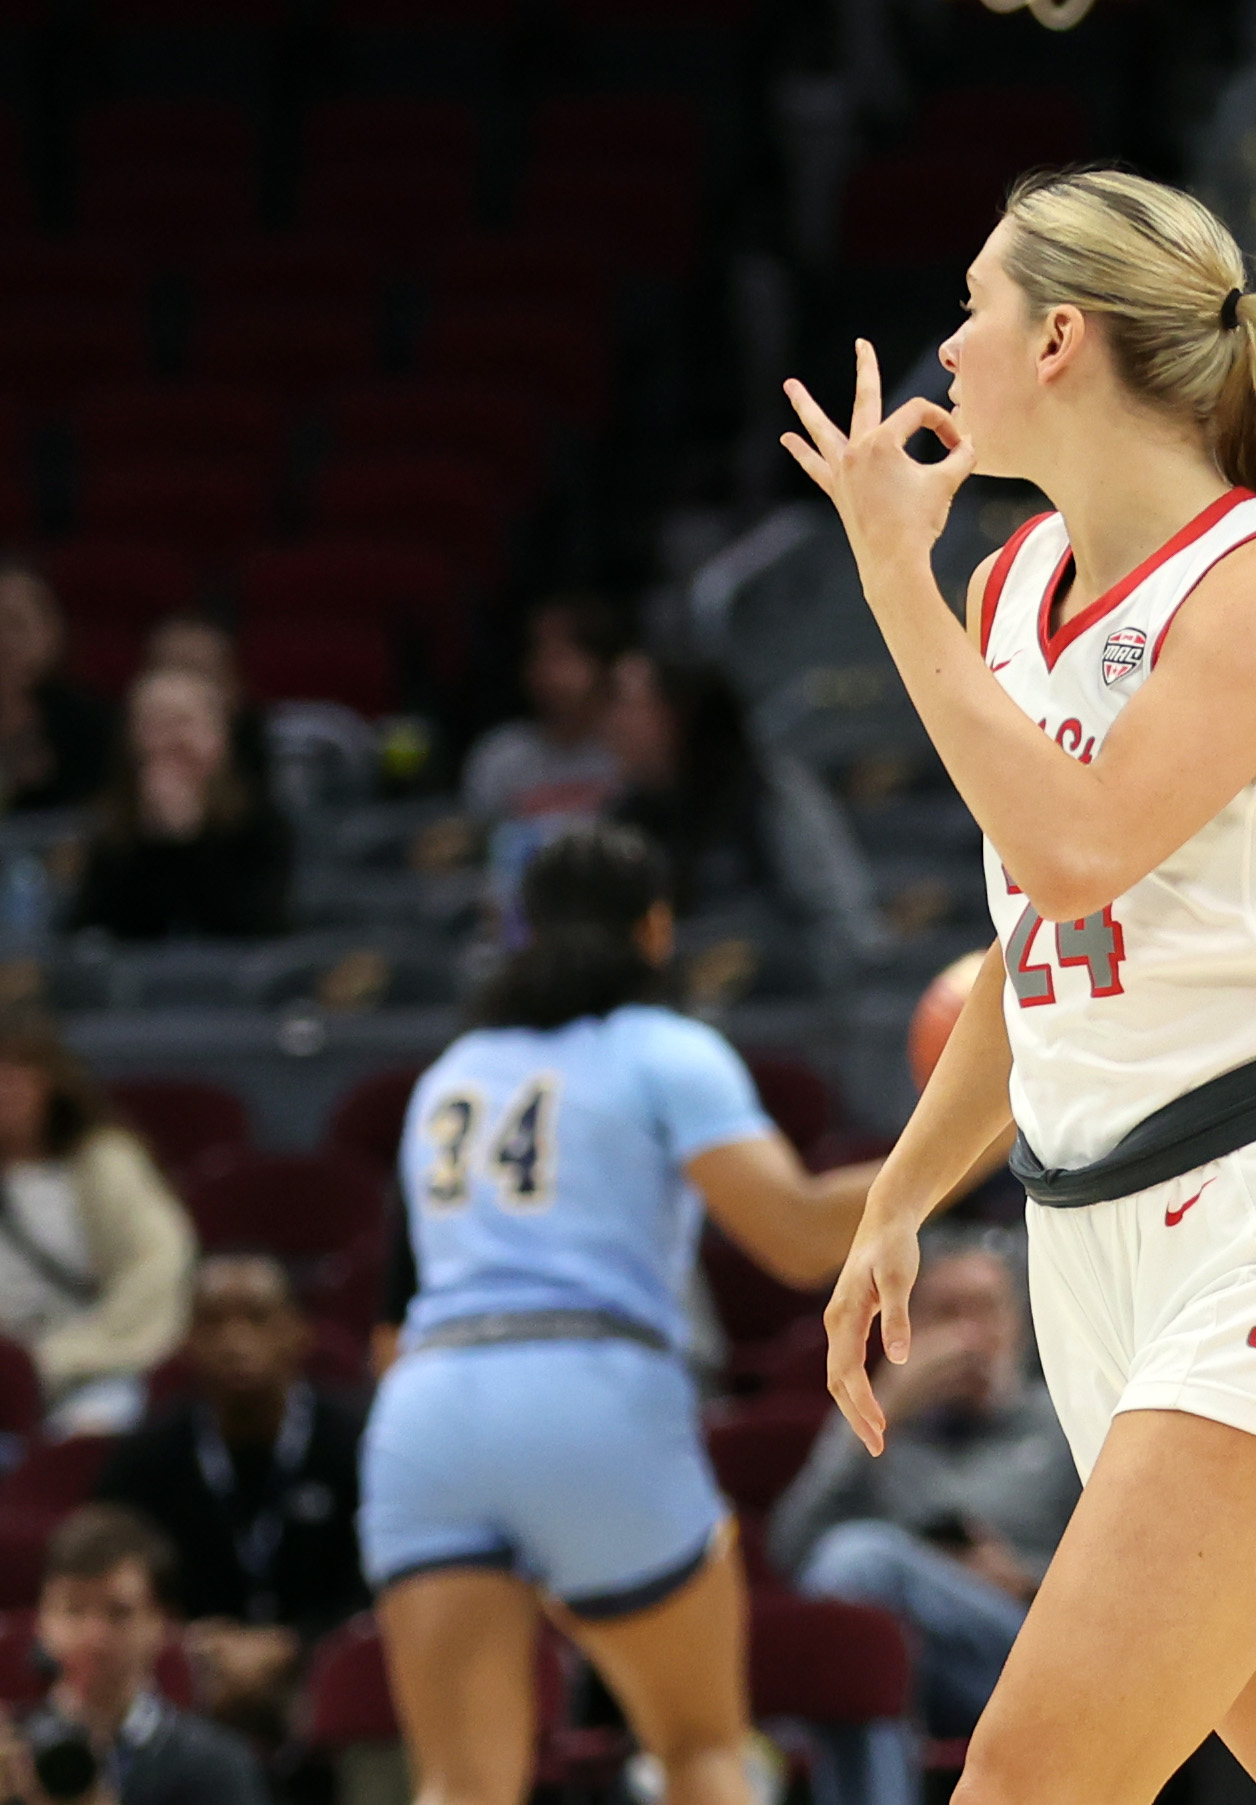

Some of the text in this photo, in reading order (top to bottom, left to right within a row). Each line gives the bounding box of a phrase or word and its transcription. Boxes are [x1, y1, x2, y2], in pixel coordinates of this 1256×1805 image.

[1103, 645, 1143, 664] MAC
[1002, 864, 1126, 1008] 24
[423, 1067, 567, 1216] 34
